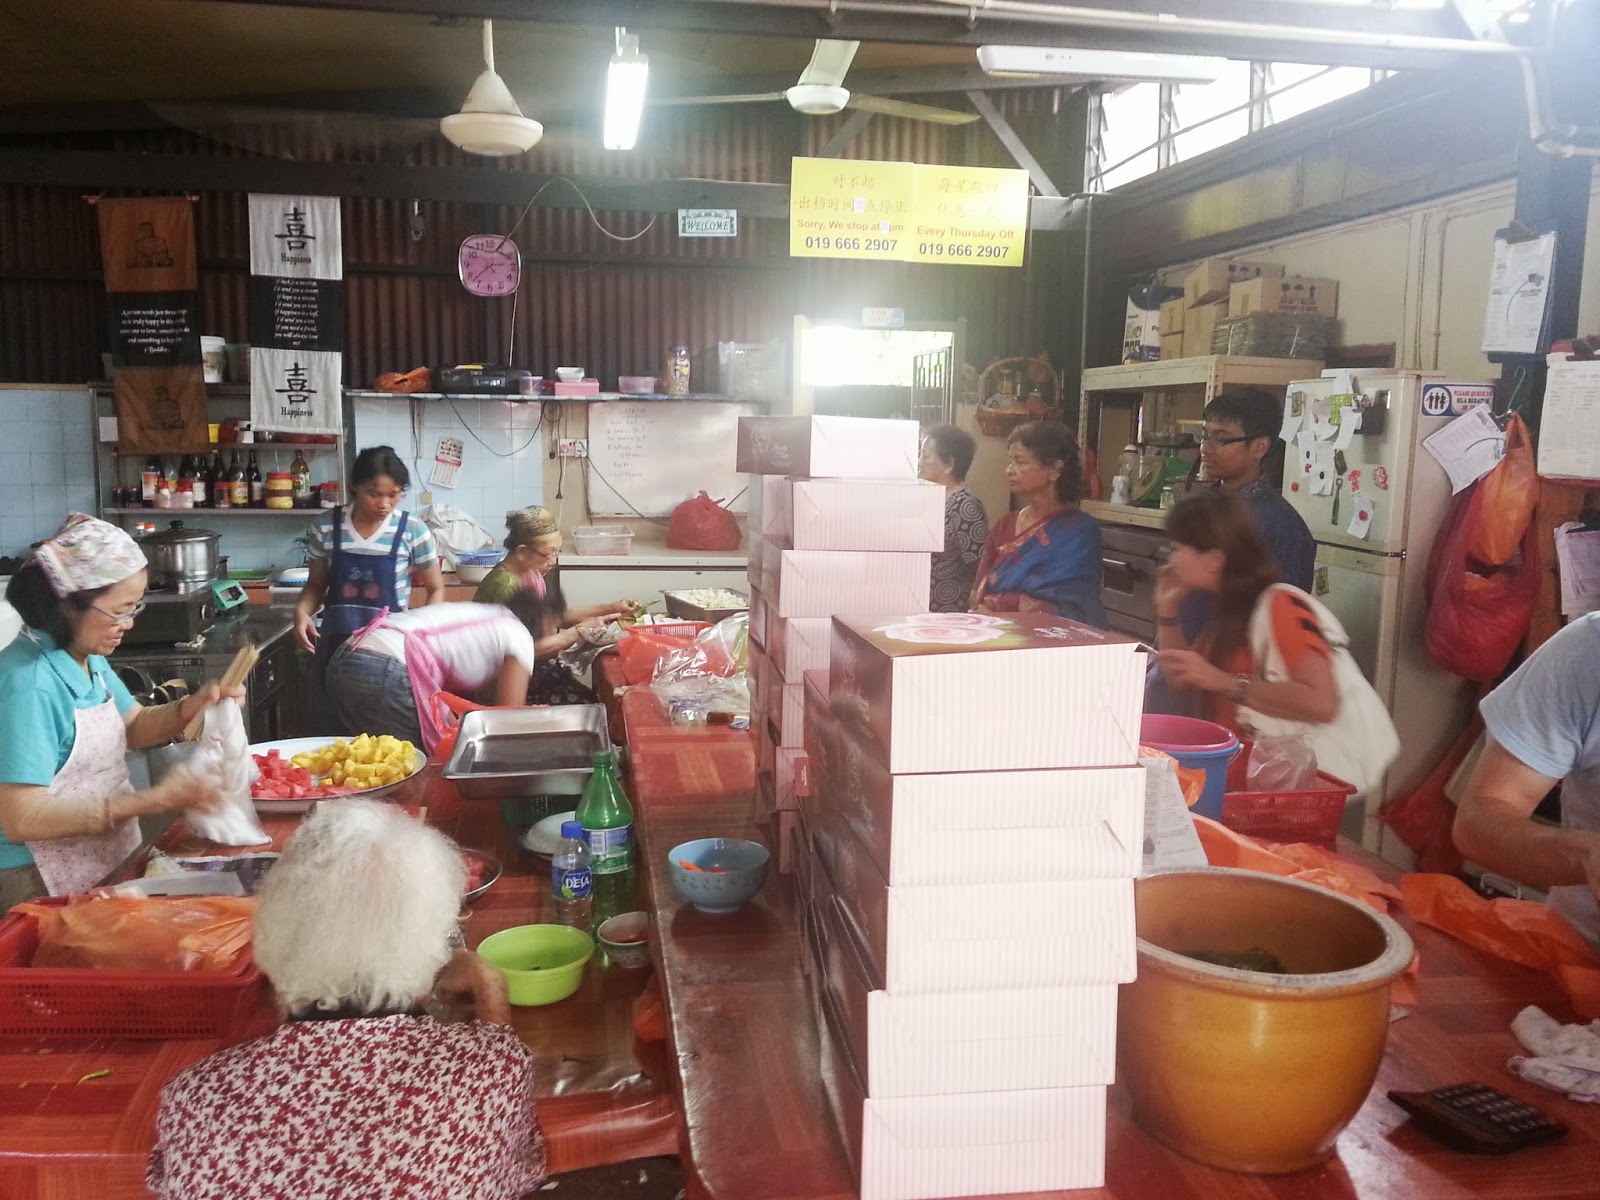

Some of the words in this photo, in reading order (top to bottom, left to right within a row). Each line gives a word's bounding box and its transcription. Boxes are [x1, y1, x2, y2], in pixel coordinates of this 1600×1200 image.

[274, 207, 316, 252] 喜
[687, 219, 730, 232] WELCOME
[797, 218, 826, 231] Sorry,
[829, 219, 845, 230] We
[847, 220, 869, 232] stop
[870, 222, 880, 231] at
[917, 225, 946, 239] Every
[949, 226, 996, 240] Thursday
[998, 229, 1015, 239] Off
[486, 240, 495, 248] 12
[805, 236, 831, 250] 019
[835, 237, 860, 251] 666
[865, 238, 898, 252] 2907
[919, 242, 944, 256] 019
[948, 243, 973, 257] 666
[977, 245, 1010, 259] 2907
[280, 252, 312, 265] Happiness
[275, 362, 317, 405] 喜
[280, 407, 313, 418] Happiness
[566, 876, 589, 889] DESA
